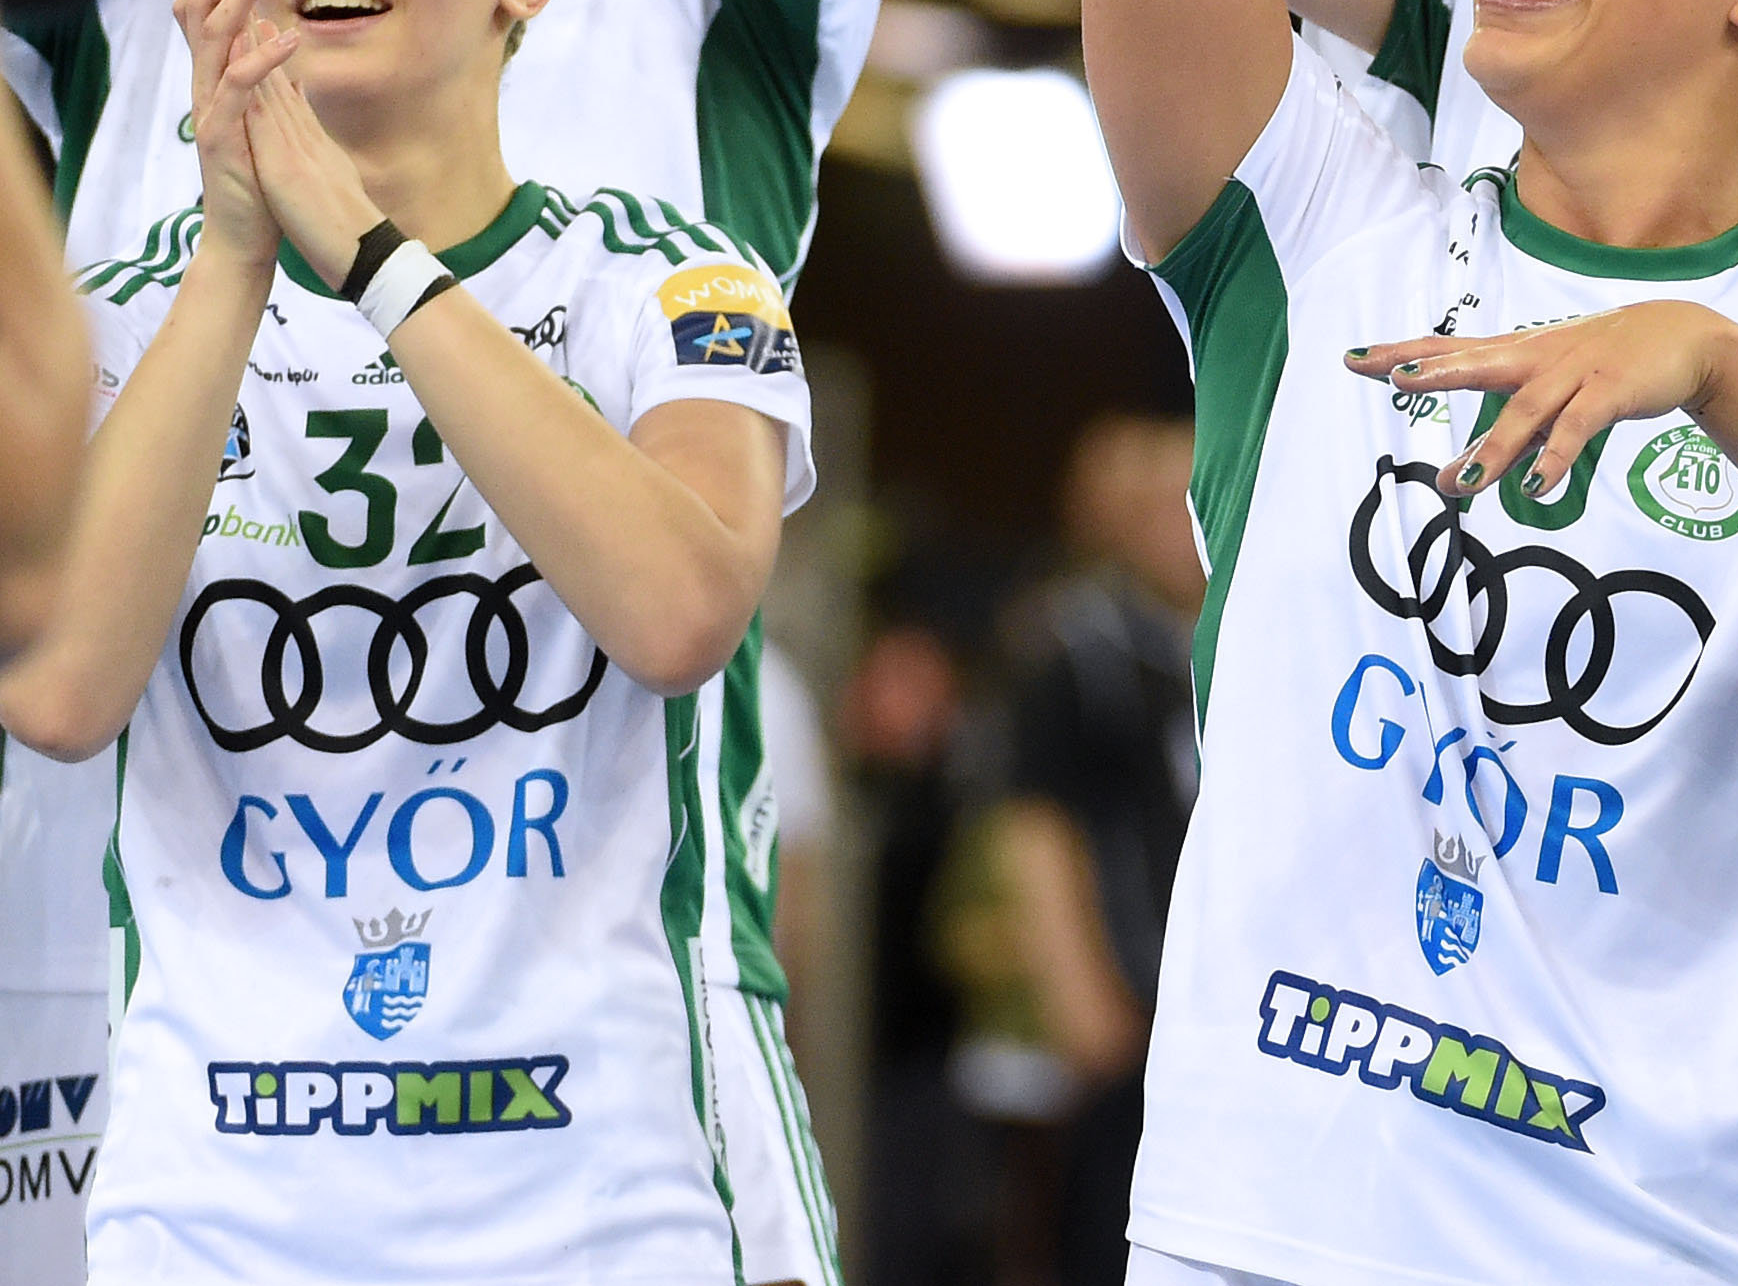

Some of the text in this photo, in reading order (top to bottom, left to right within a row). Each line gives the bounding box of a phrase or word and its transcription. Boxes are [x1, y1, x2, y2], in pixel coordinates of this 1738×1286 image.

[299, 409, 486, 569] 32
[1660, 515, 1724, 538] CLUB
[220, 758, 571, 901] GYŐR
[216, 1068, 562, 1127] TiPPMIX
[1266, 985, 1594, 1152] TiPPMIX
